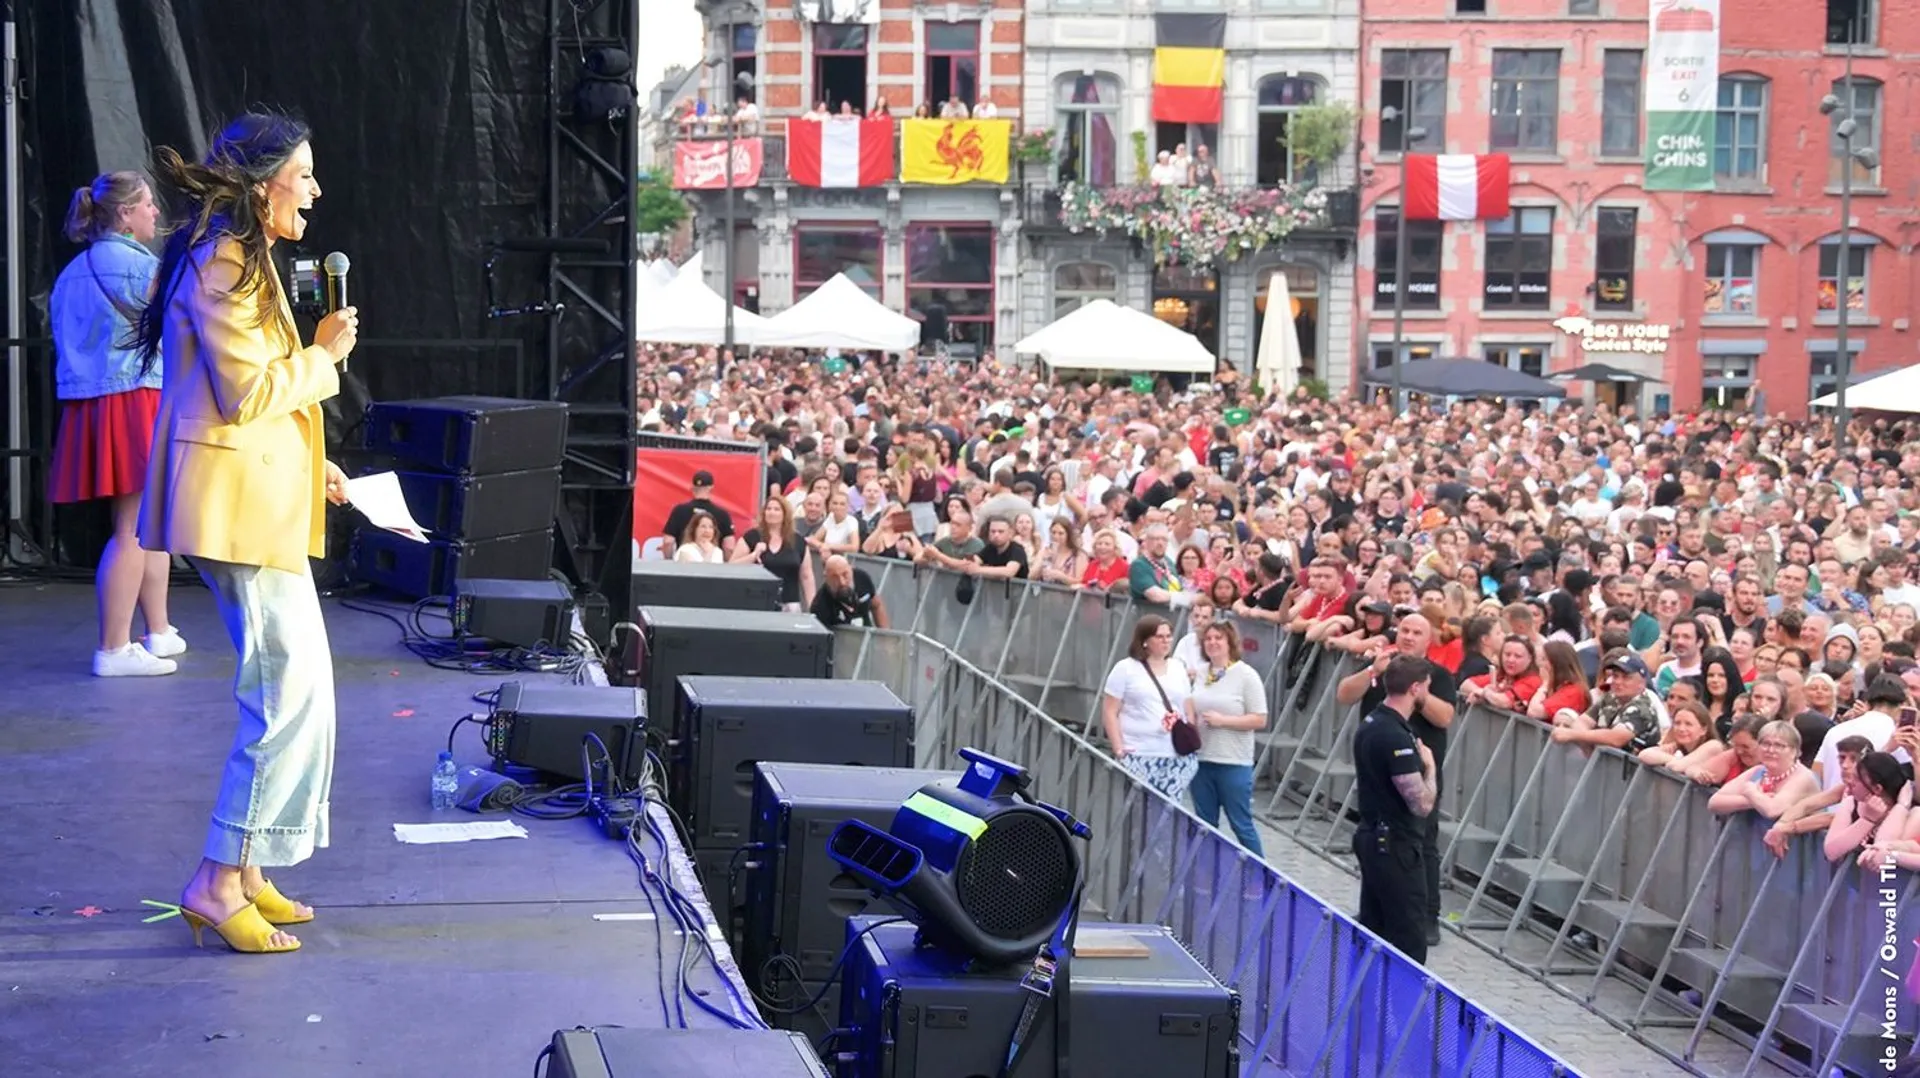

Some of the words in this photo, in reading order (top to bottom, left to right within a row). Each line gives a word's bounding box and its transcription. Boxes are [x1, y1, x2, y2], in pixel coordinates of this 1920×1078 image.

[1671, 71, 1698, 81] EXIT
[1678, 88, 1690, 103] 6
[1657, 134, 1705, 150] CHIN-
[1653, 152, 1708, 167] CHINS
[1623, 324, 1670, 338] HOME
